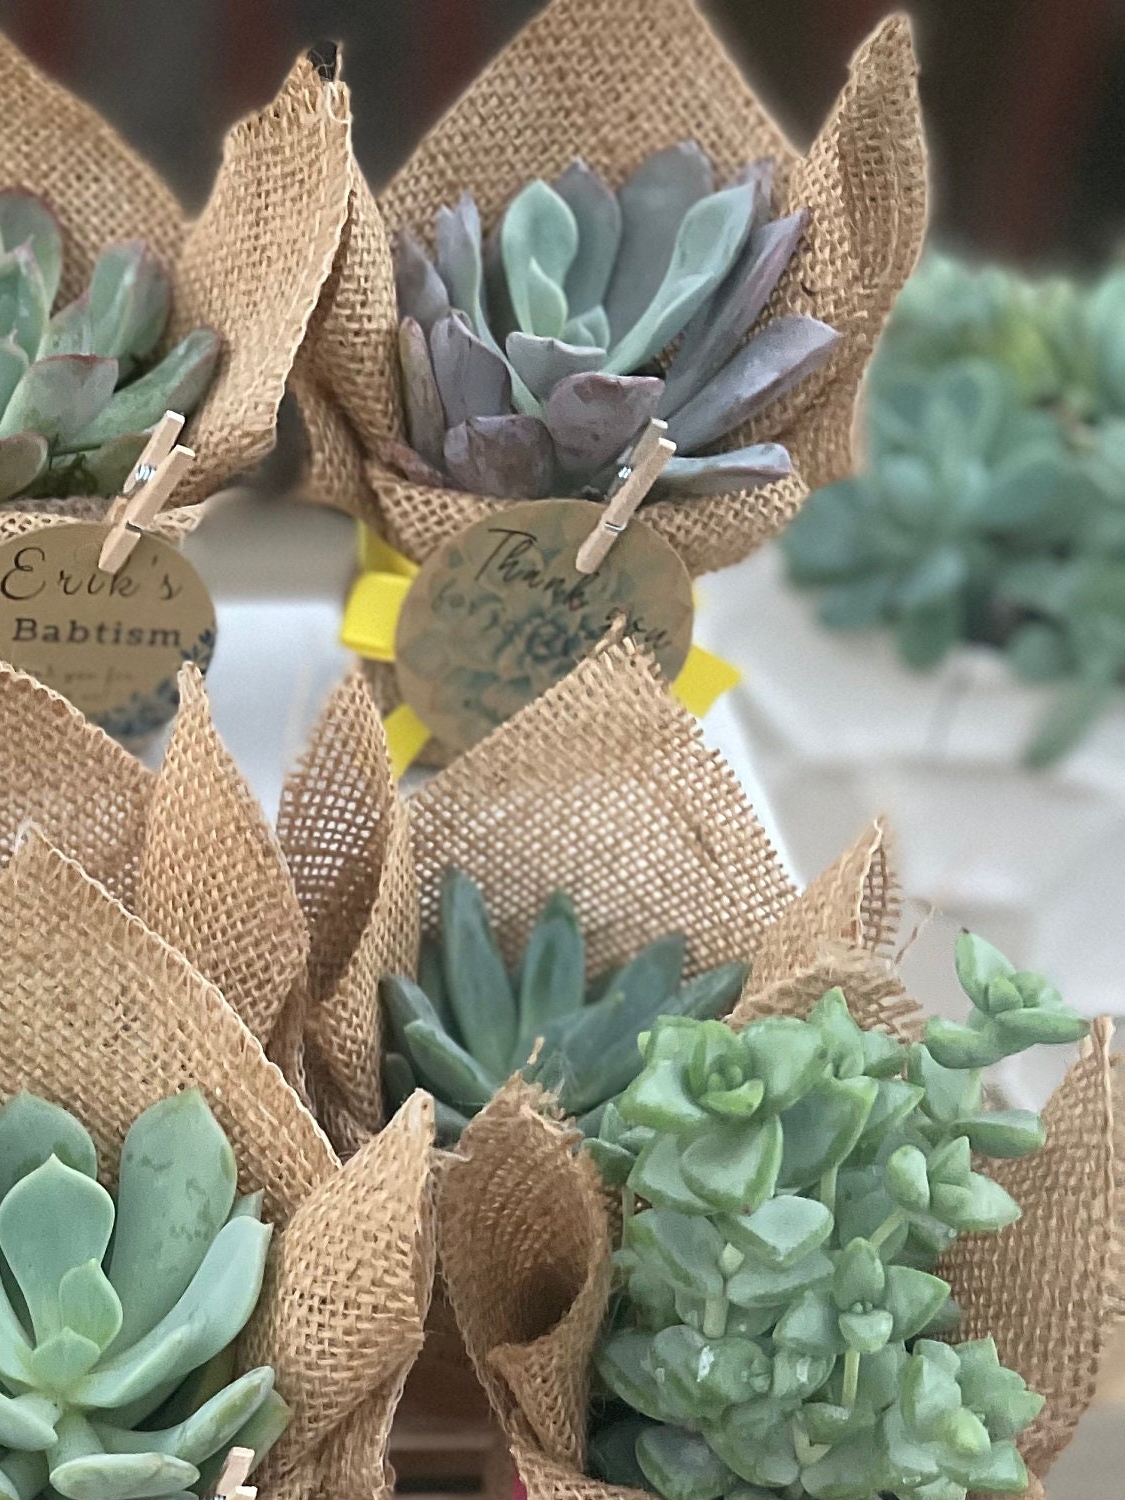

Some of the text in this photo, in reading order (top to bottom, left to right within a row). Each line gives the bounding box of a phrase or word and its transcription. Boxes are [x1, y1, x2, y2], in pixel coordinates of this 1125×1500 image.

[0, 546, 183, 601] Erik's
[475, 527, 601, 613] Thank
[12, 618, 181, 647] Babtism
